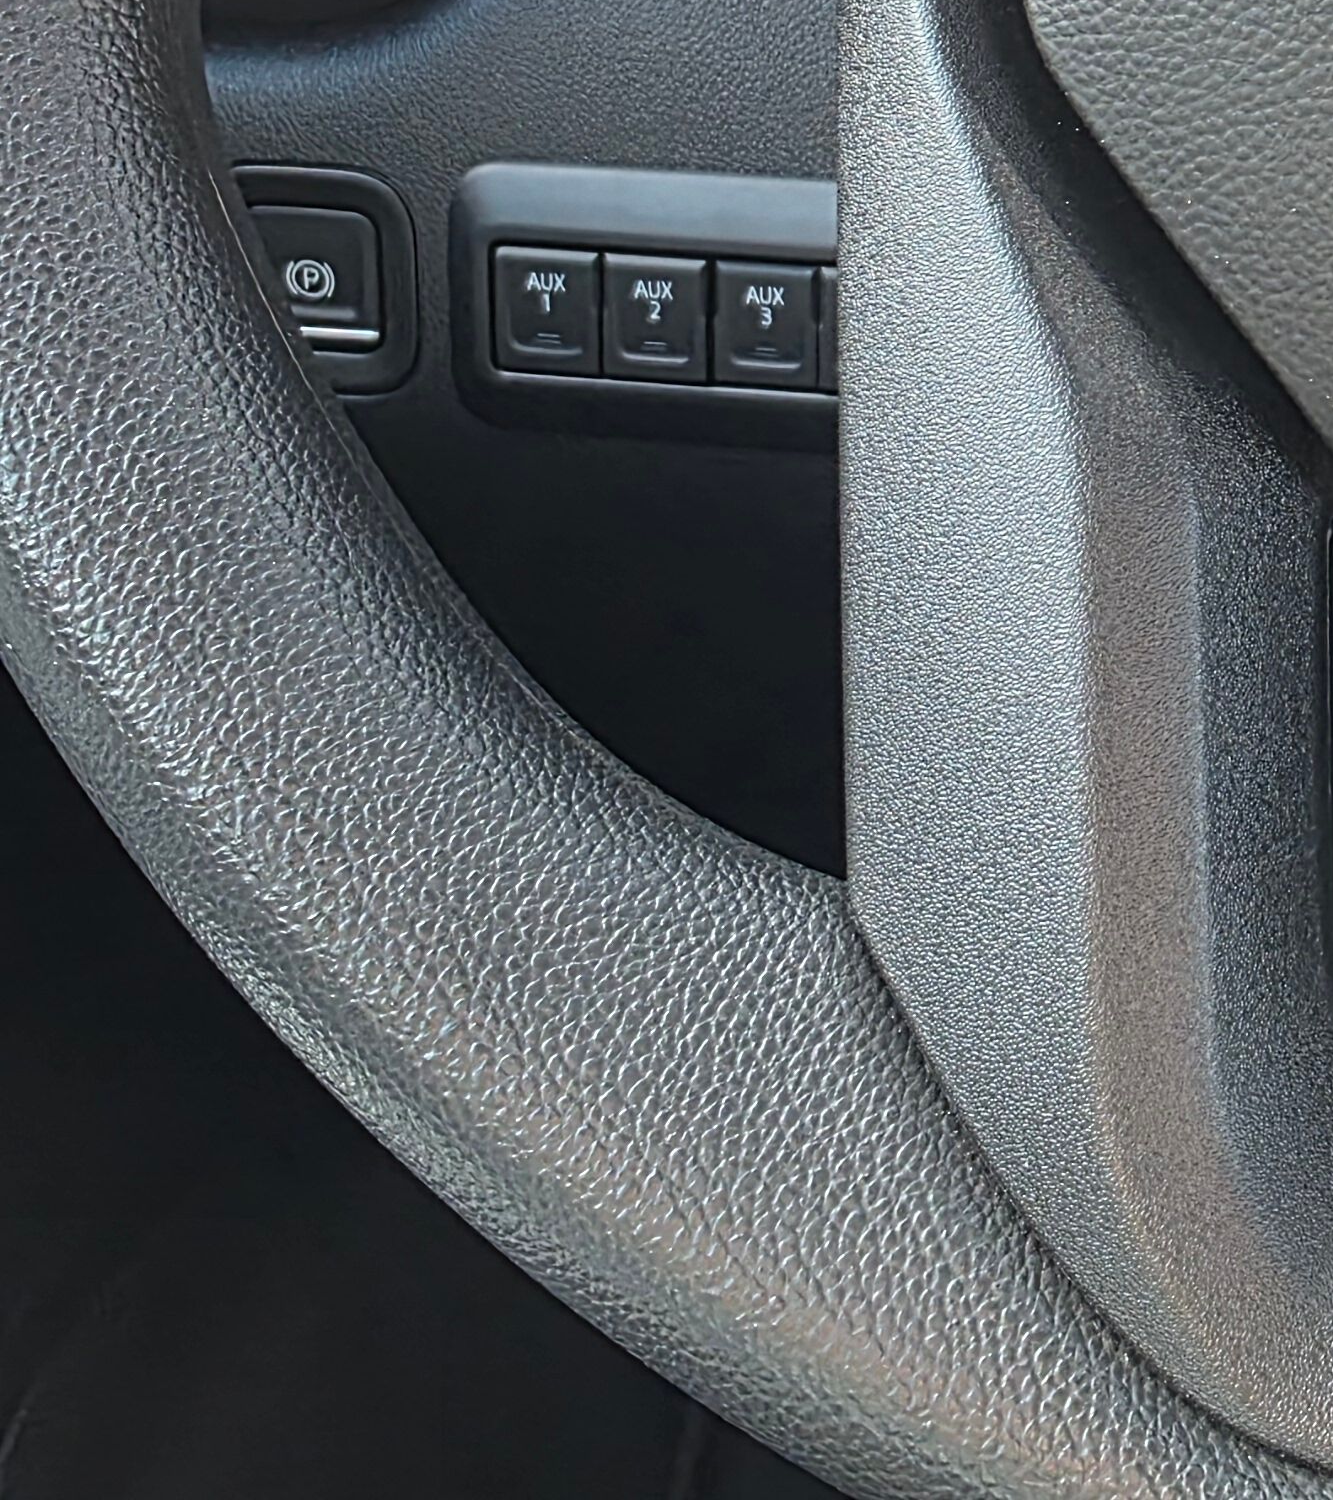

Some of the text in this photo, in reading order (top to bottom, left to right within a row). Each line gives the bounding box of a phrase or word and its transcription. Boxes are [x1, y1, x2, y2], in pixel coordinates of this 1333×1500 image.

[527, 272, 567, 293] AUX
[634, 280, 674, 301] AUX
[746, 286, 786, 307] AUX
[650, 301, 662, 320] 2
[760, 307, 774, 327] 3
